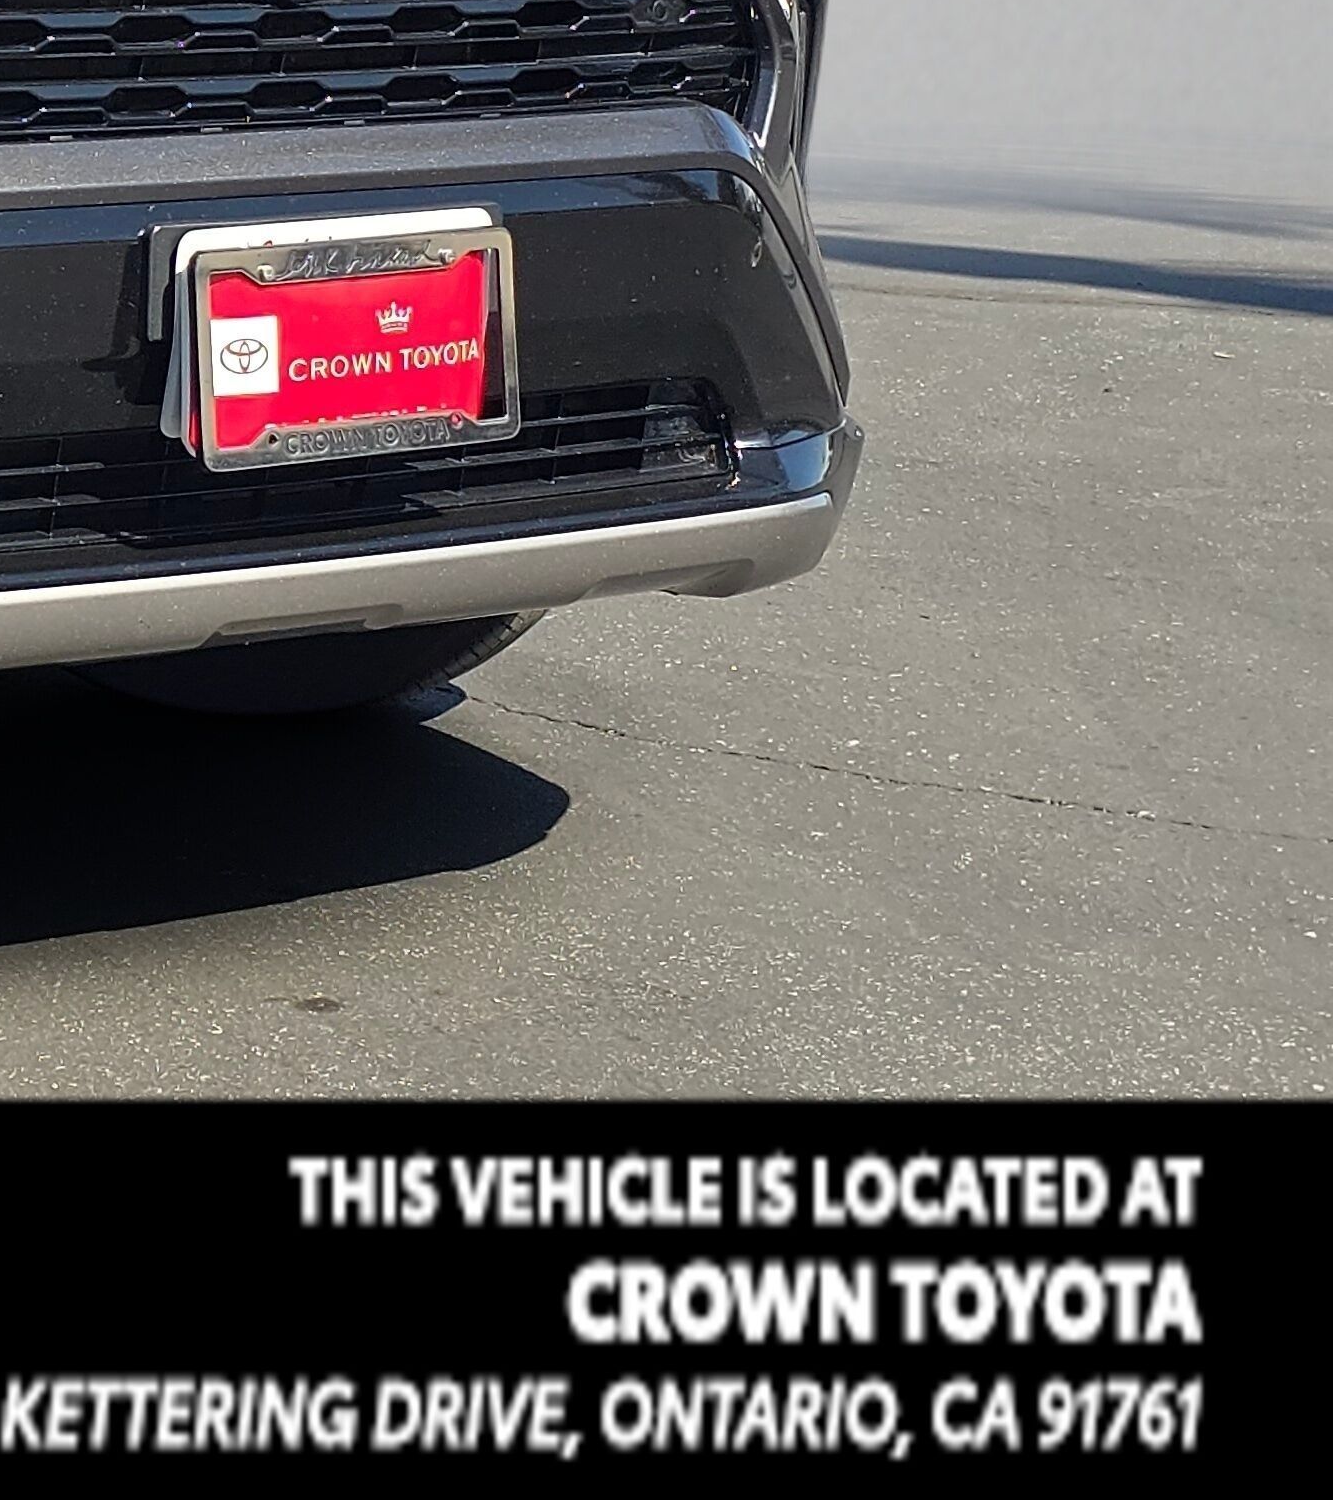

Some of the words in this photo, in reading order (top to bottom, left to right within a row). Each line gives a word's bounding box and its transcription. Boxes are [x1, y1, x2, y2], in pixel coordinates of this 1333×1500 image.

[288, 352, 393, 382] CROWN
[399, 336, 480, 372] TOYOTA
[285, 425, 367, 456] CROWN
[372, 417, 451, 448] TOYOTA
